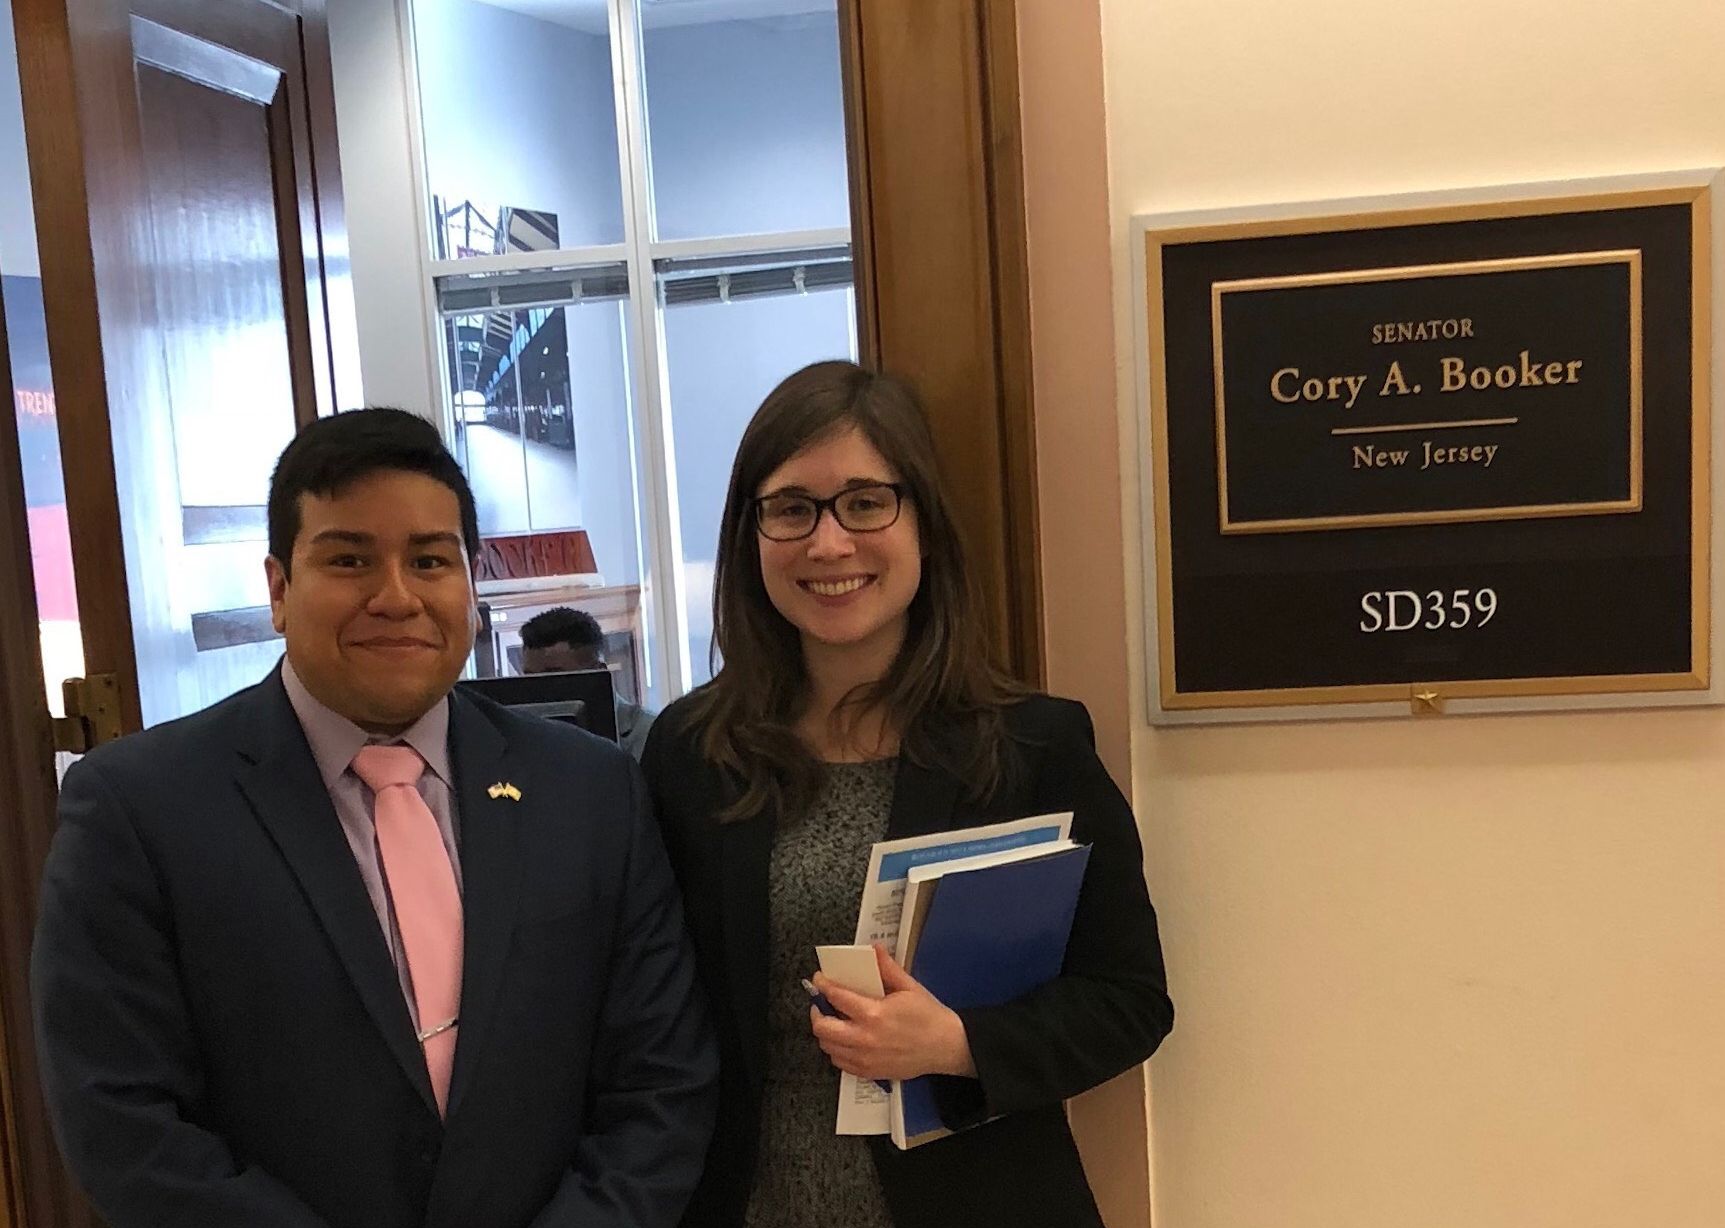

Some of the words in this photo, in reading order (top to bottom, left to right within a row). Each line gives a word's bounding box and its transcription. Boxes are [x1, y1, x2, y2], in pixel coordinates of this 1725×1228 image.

[1372, 318, 1474, 345] SENATOR
[1270, 367, 1368, 409] Cory
[1379, 360, 1422, 397] A.
[1440, 350, 1584, 392] Booker
[1352, 445, 1409, 469] New
[1420, 441, 1499, 470] Jersey
[1359, 587, 1498, 633] SD359
